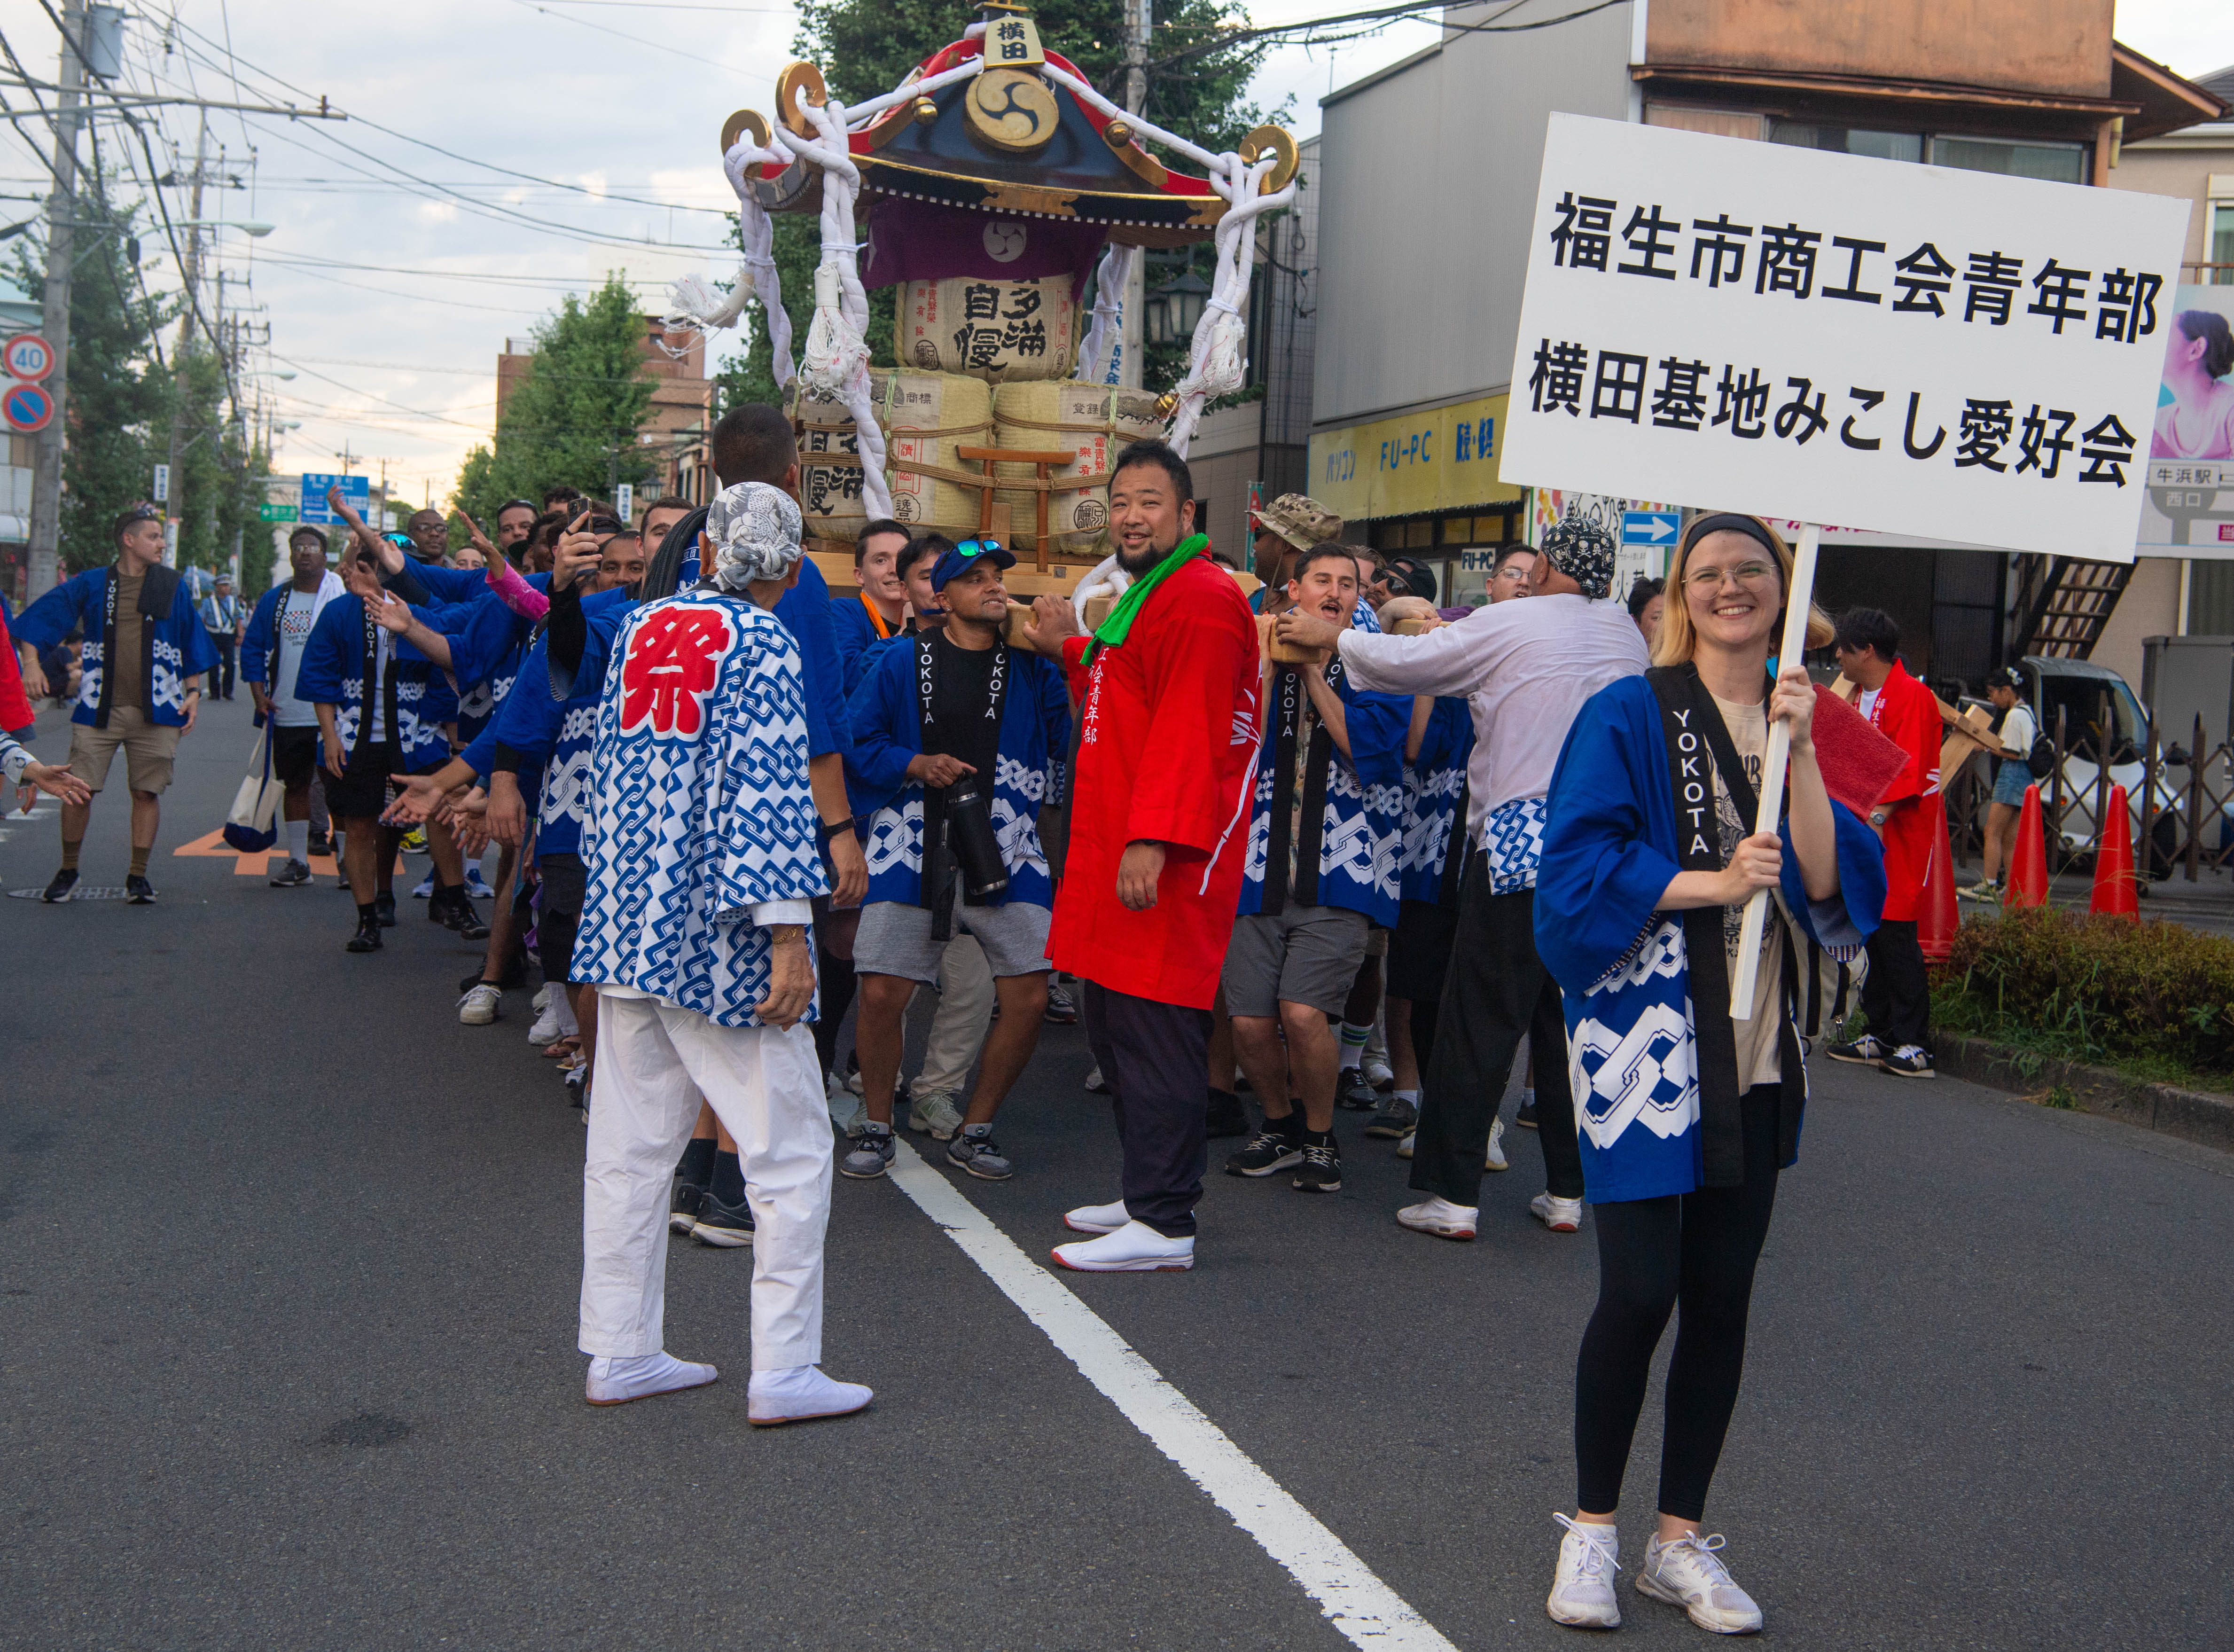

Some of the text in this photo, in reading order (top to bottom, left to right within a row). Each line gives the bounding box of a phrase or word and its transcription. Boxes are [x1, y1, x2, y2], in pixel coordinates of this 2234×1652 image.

[997, 22, 1028, 59] 横田
[1550, 192, 2164, 344] 福生市商工会青年部
[953, 283, 1008, 371] 自慢
[15, 348, 43, 369] 40
[906, 392, 931, 405] 商標
[1073, 403, 1099, 414] 登録
[1528, 338, 2137, 489] 横田基地みこし愛好会
[1094, 437, 1106, 475] 富貴繁
[1326, 450, 1356, 484] パソコン
[1380, 430, 1432, 471] FU-PC
[2157, 468, 2211, 484] 牛浜駅
[2166, 492, 2201, 507] 西口
[1461, 551, 1493, 571] FU-PC
[106, 579, 117, 626] YOKOTA
[274, 591, 289, 632] YOKOTA
[365, 603, 375, 658] OKOTA
[621, 606, 730, 734] 祭
[921, 642, 934, 724] YOKOTA
[1282, 670, 1296, 737] OKOTA
[1672, 709, 1710, 855] YOKOTA
